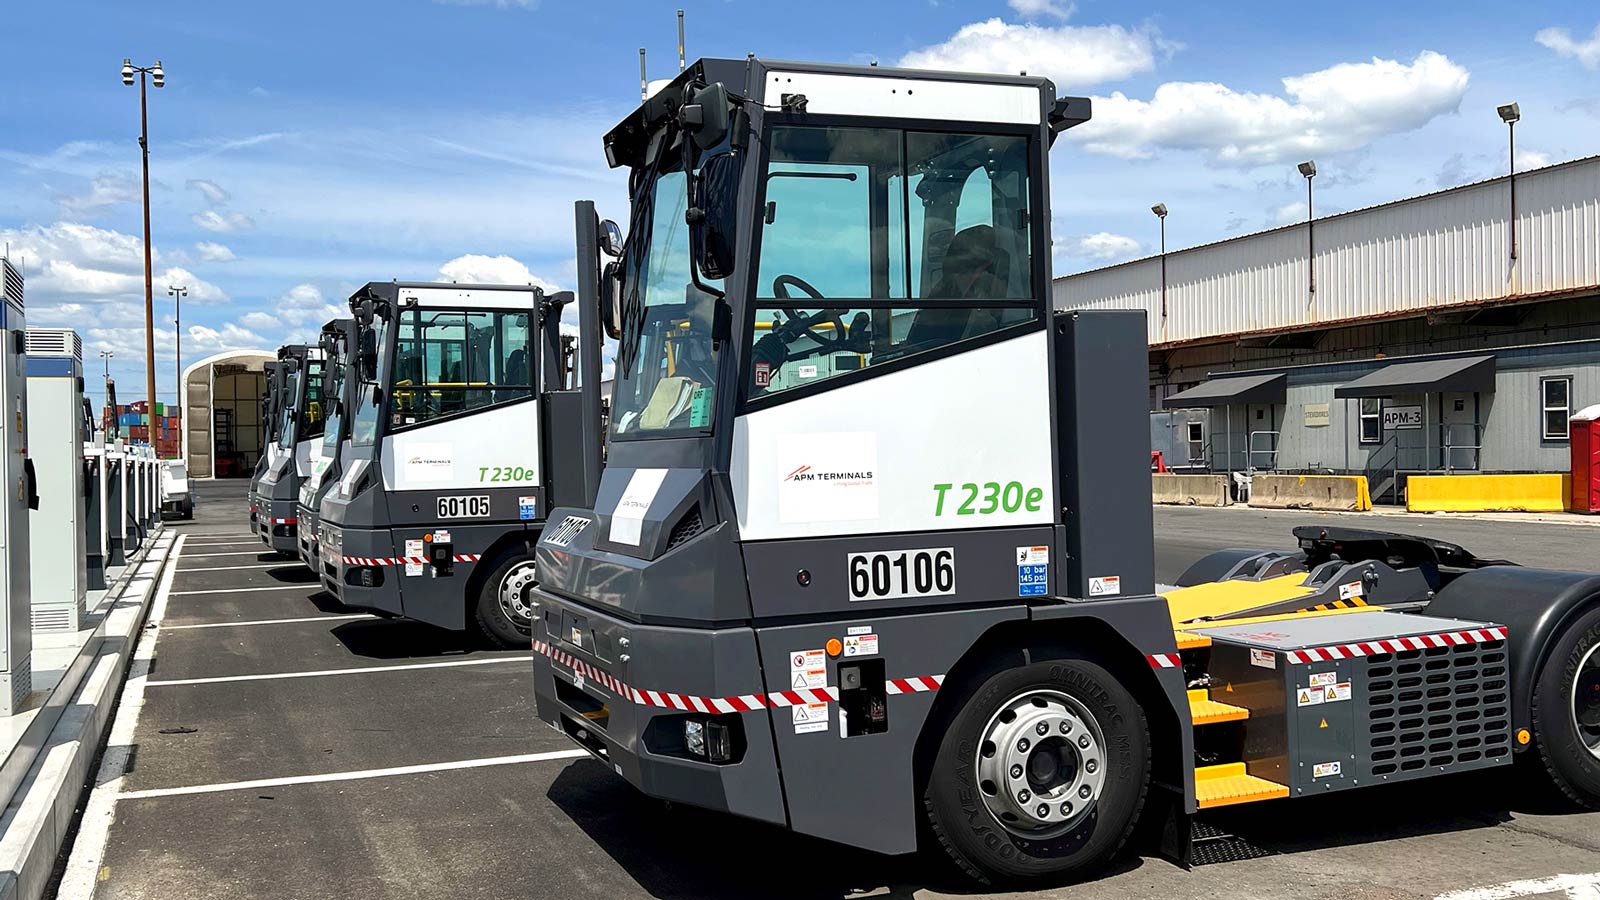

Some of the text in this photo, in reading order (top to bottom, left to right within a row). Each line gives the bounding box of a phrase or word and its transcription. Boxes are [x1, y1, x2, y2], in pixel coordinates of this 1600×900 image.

[1384, 411, 1421, 424] APM-3
[479, 466, 534, 482] T 230e
[793, 471, 873, 482] APM TERMINALS
[438, 496, 489, 517] 60105
[933, 480, 1044, 517] T 230e
[850, 550, 954, 598] 60106
[1020, 574, 1046, 583] 145 psi
[1023, 566, 1046, 574] 10 bar
[1050, 664, 1124, 727] OMNITRAC
[955, 739, 1034, 864] OODYEAR
